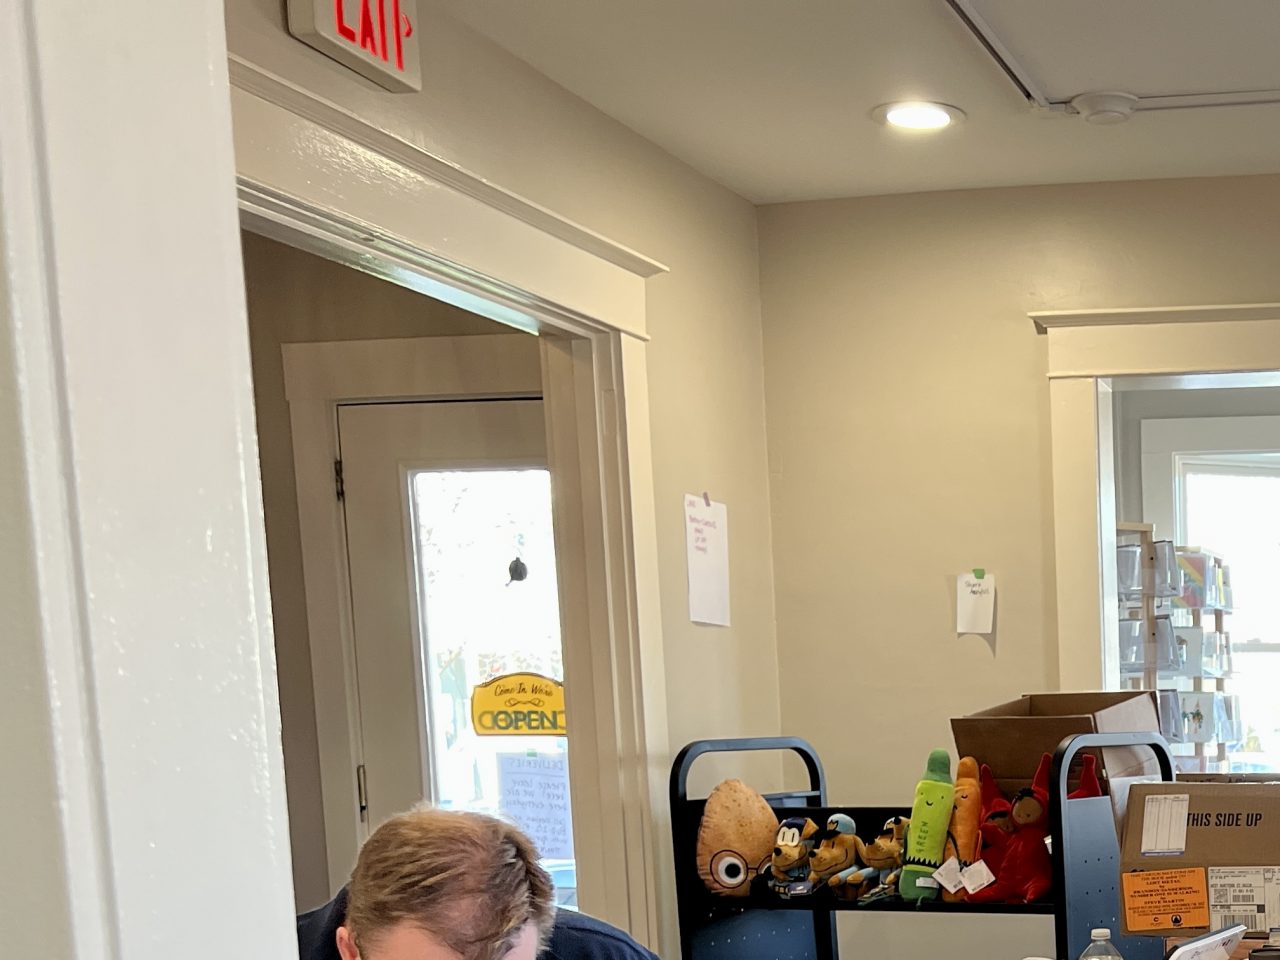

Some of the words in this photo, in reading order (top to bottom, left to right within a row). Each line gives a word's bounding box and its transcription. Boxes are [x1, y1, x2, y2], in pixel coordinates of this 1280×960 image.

[494, 683, 516, 697] Come
[516, 682, 527, 695] In
[493, 710, 558, 730] OPEN
[1187, 813, 1211, 827] THIS
[1215, 813, 1243, 827] SIDE
[1246, 813, 1263, 827] UP
[916, 821, 929, 853] GREEN
